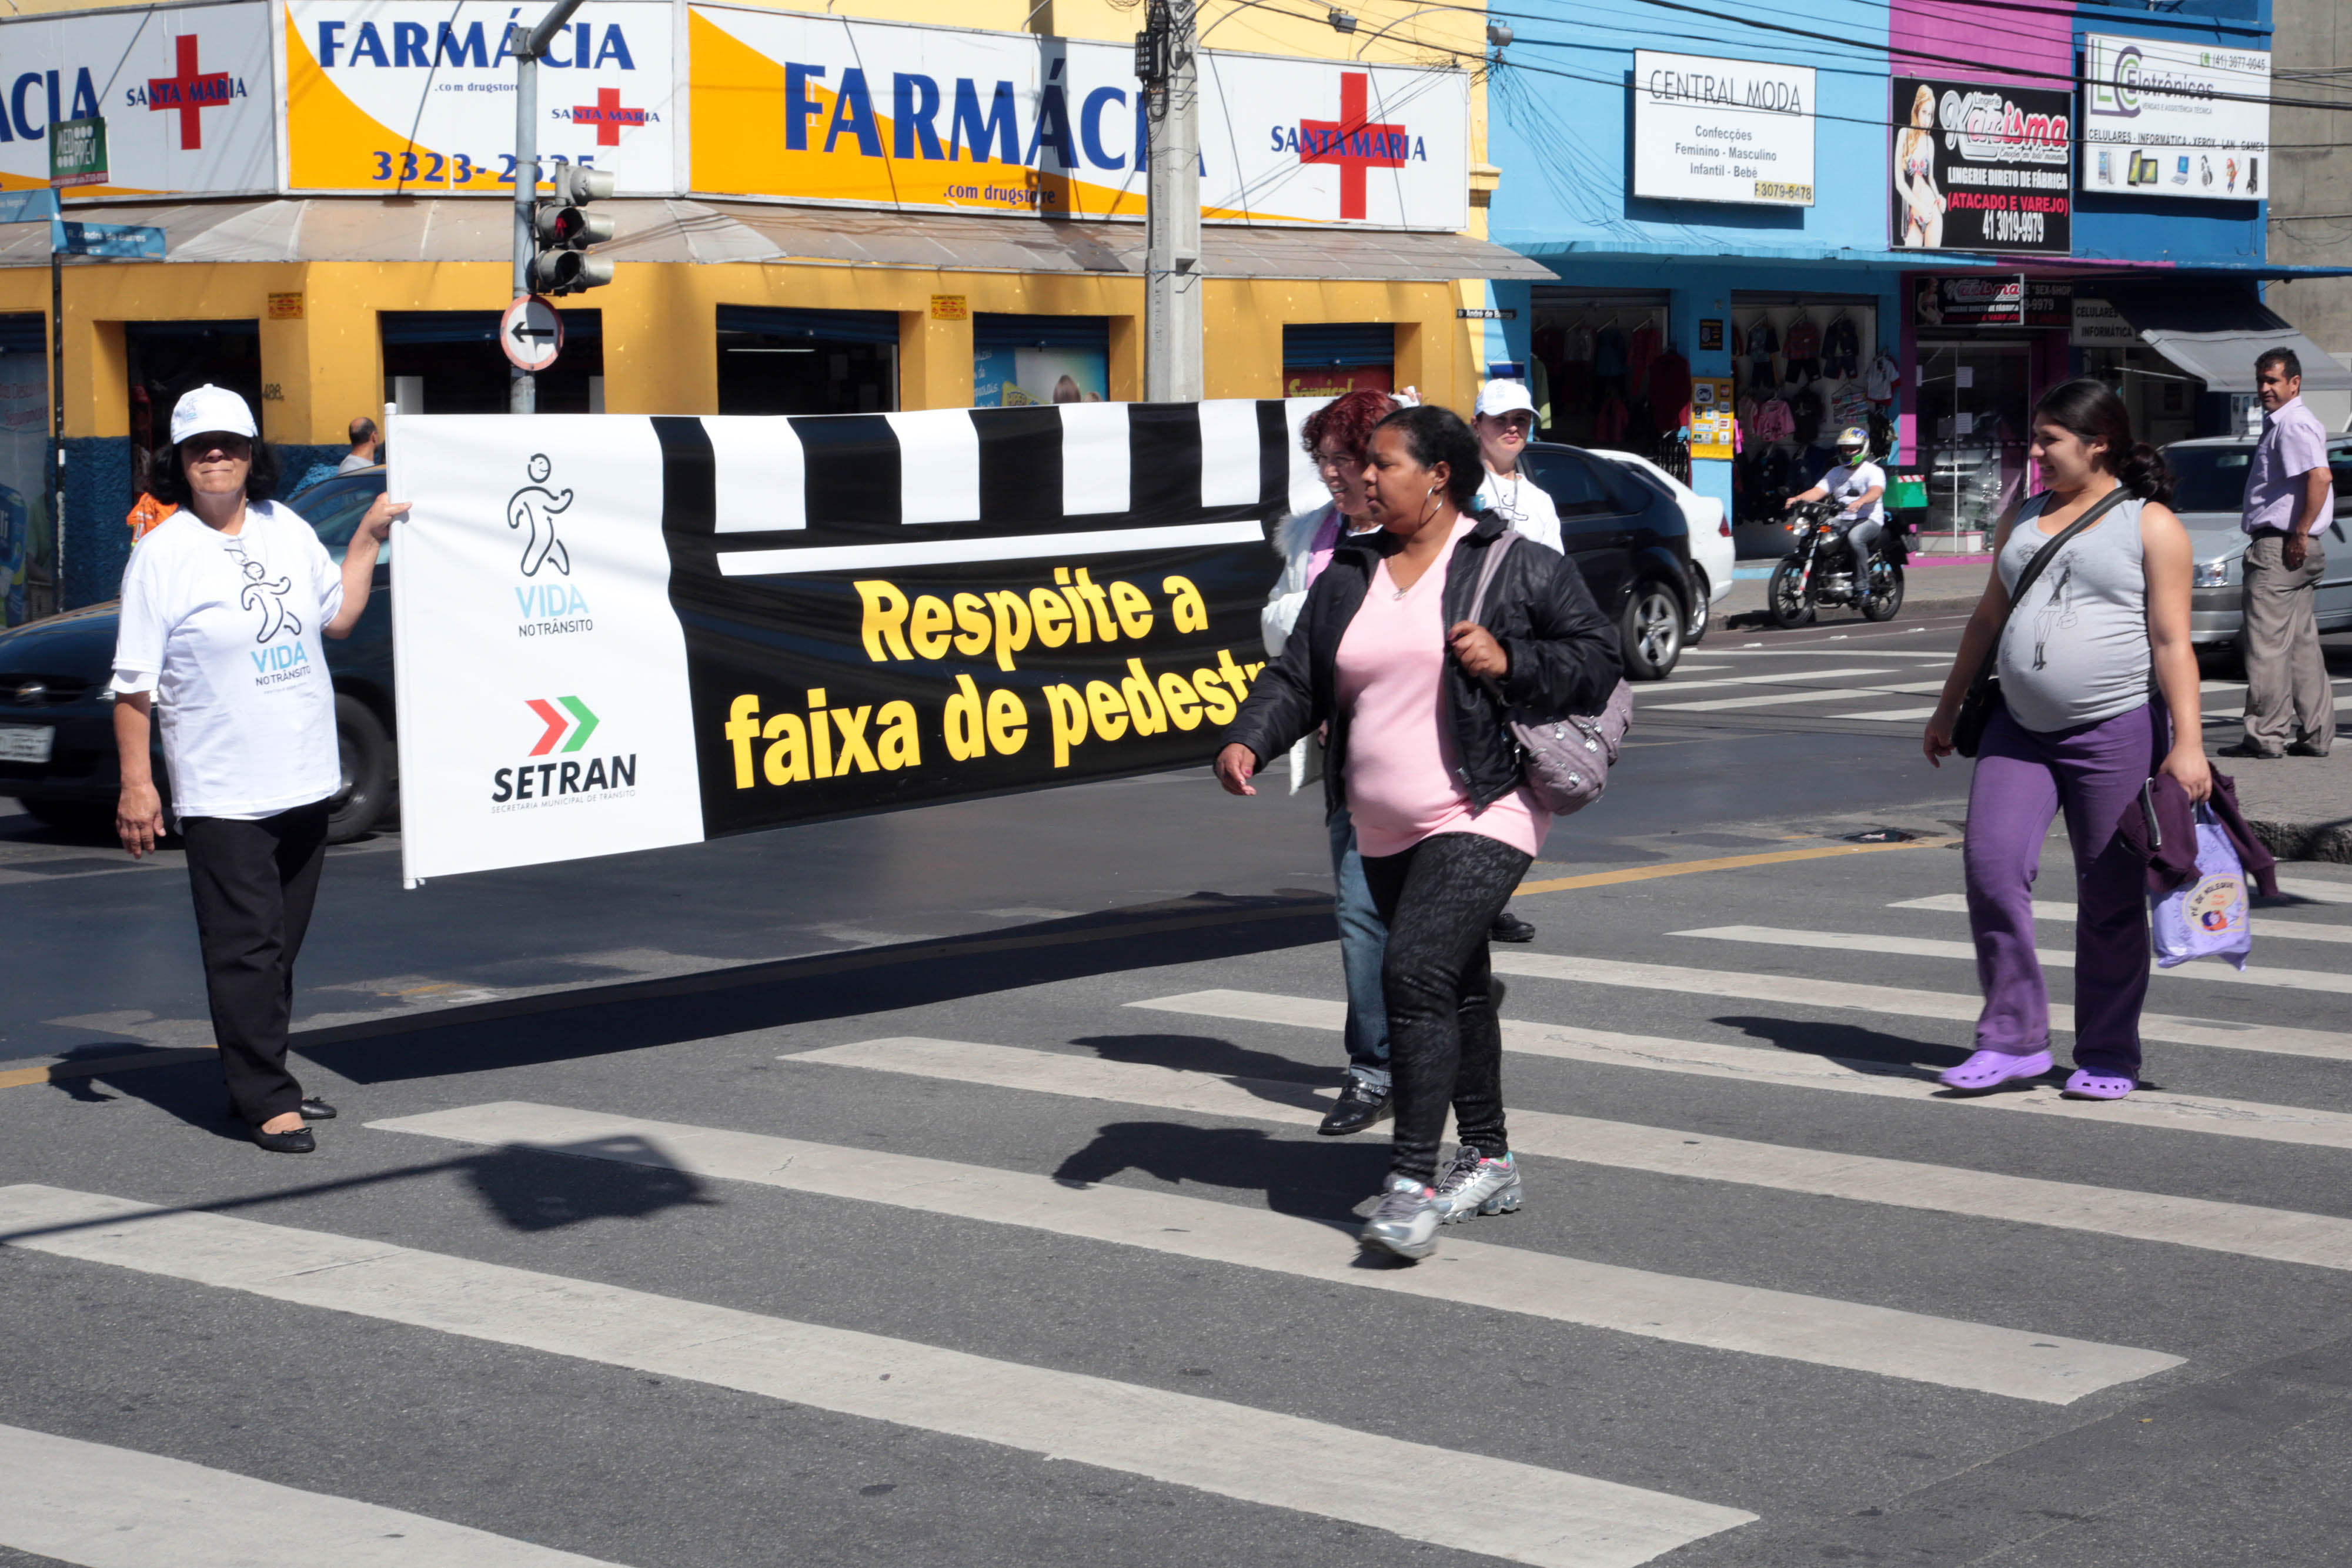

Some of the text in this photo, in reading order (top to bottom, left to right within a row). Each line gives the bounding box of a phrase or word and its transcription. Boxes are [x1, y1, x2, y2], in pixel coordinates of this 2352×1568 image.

[126, 78, 247, 107] SANTA MARIA
[1651, 70, 1801, 113] CENTRAL MODA
[552, 108, 660, 123] SANTA MARIA
[1940, 91, 2068, 155] Karisma
[1271, 125, 1427, 162] SANTA MARIA
[1695, 125, 1752, 142] Confecções
[2089, 129, 2132, 143] CELULARES
[2138, 132, 2187, 146] INFORMÁTICA
[1675, 142, 1776, 161] Feminino Masculino
[1690, 163, 1758, 179] Infantil Bebê
[1947, 166, 2068, 190] LINGERIE DIRETO DE FÁBRICA
[943, 184, 1055, 205] .com drugstore
[1947, 192, 2069, 216] (ATACADO E VAREJO)
[1982, 209, 2044, 243] 41 3019-9979
[2076, 306, 2118, 318] CELULARES
[2082, 325, 2132, 338] INFORMÁTICA
[515, 584, 589, 619] VIDA
[519, 618, 593, 637] NO TRÂNSITO
[854, 567, 1209, 672] Respeite a
[251, 641, 308, 673] VIDA
[256, 665, 310, 687] NO TRÂNSITO
[724, 688, 921, 790] faixa
[943, 674, 1028, 763] de
[491, 753, 636, 803] SETRAN
[492, 789, 636, 814] SECRETARIA MUNICIPAL DE TRÂNSITO
